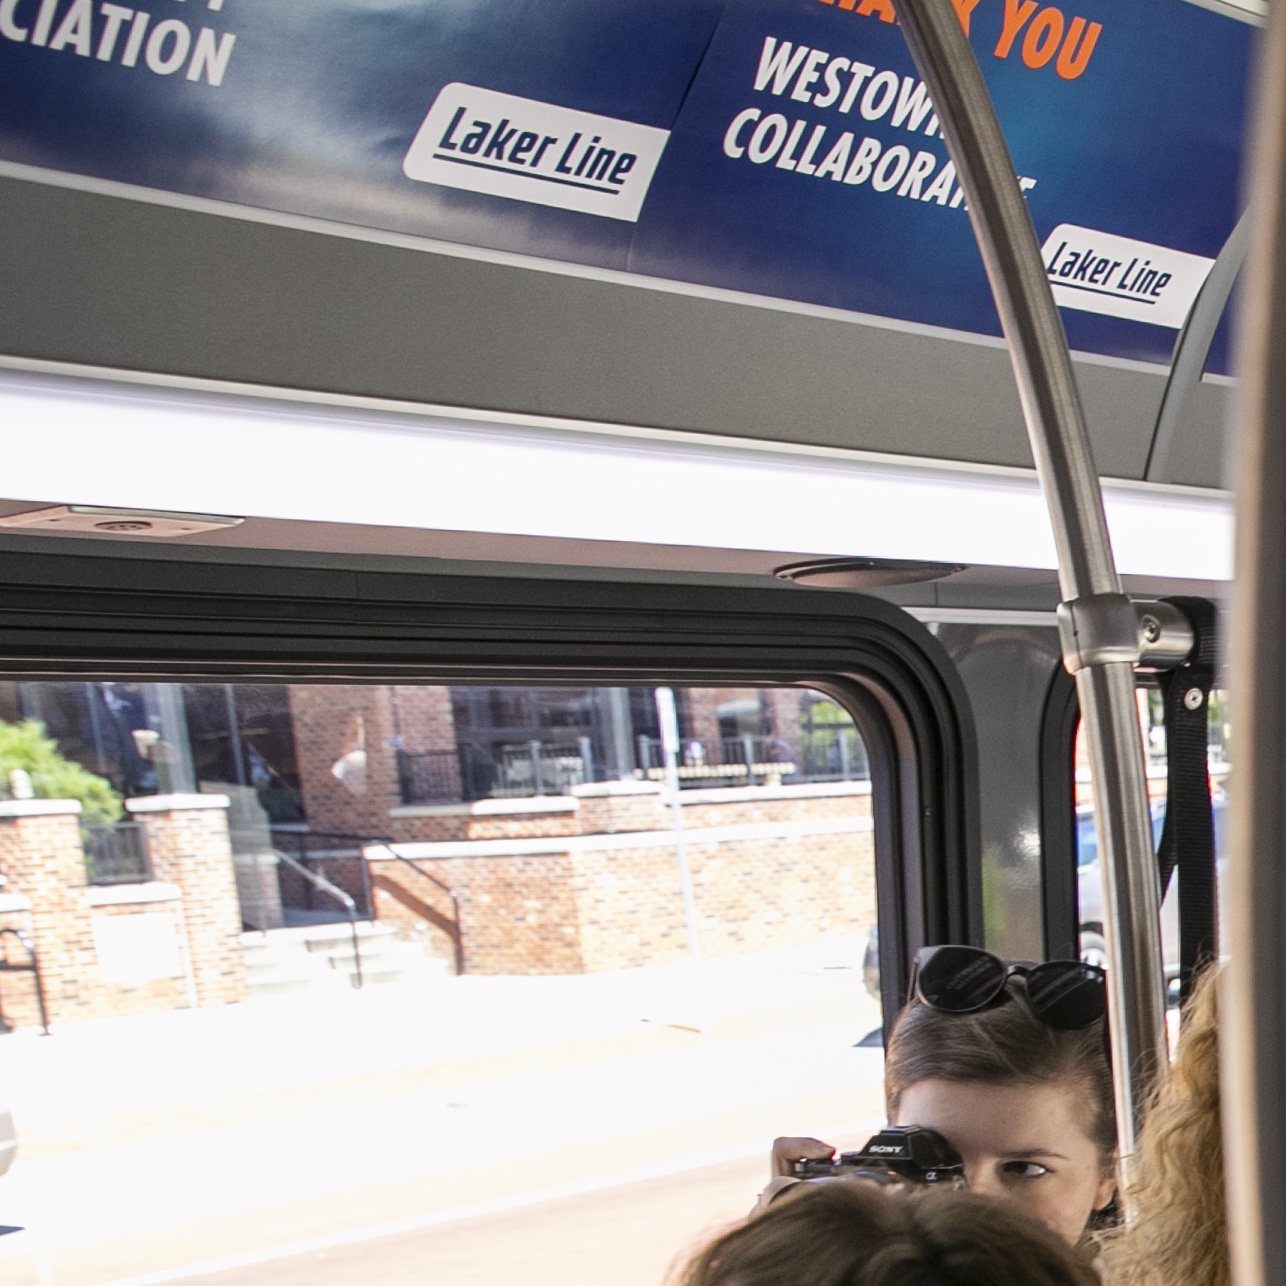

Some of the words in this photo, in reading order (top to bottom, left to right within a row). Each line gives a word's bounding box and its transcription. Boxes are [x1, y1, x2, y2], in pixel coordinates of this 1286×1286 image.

[993, 0, 1103, 80] YOU
[438, 106, 557, 168] Laker
[555, 131, 637, 187] Line
[723, 108, 1037, 211] COLLABORA
[1048, 241, 1118, 285] Laker
[1117, 257, 1172, 297] Line
